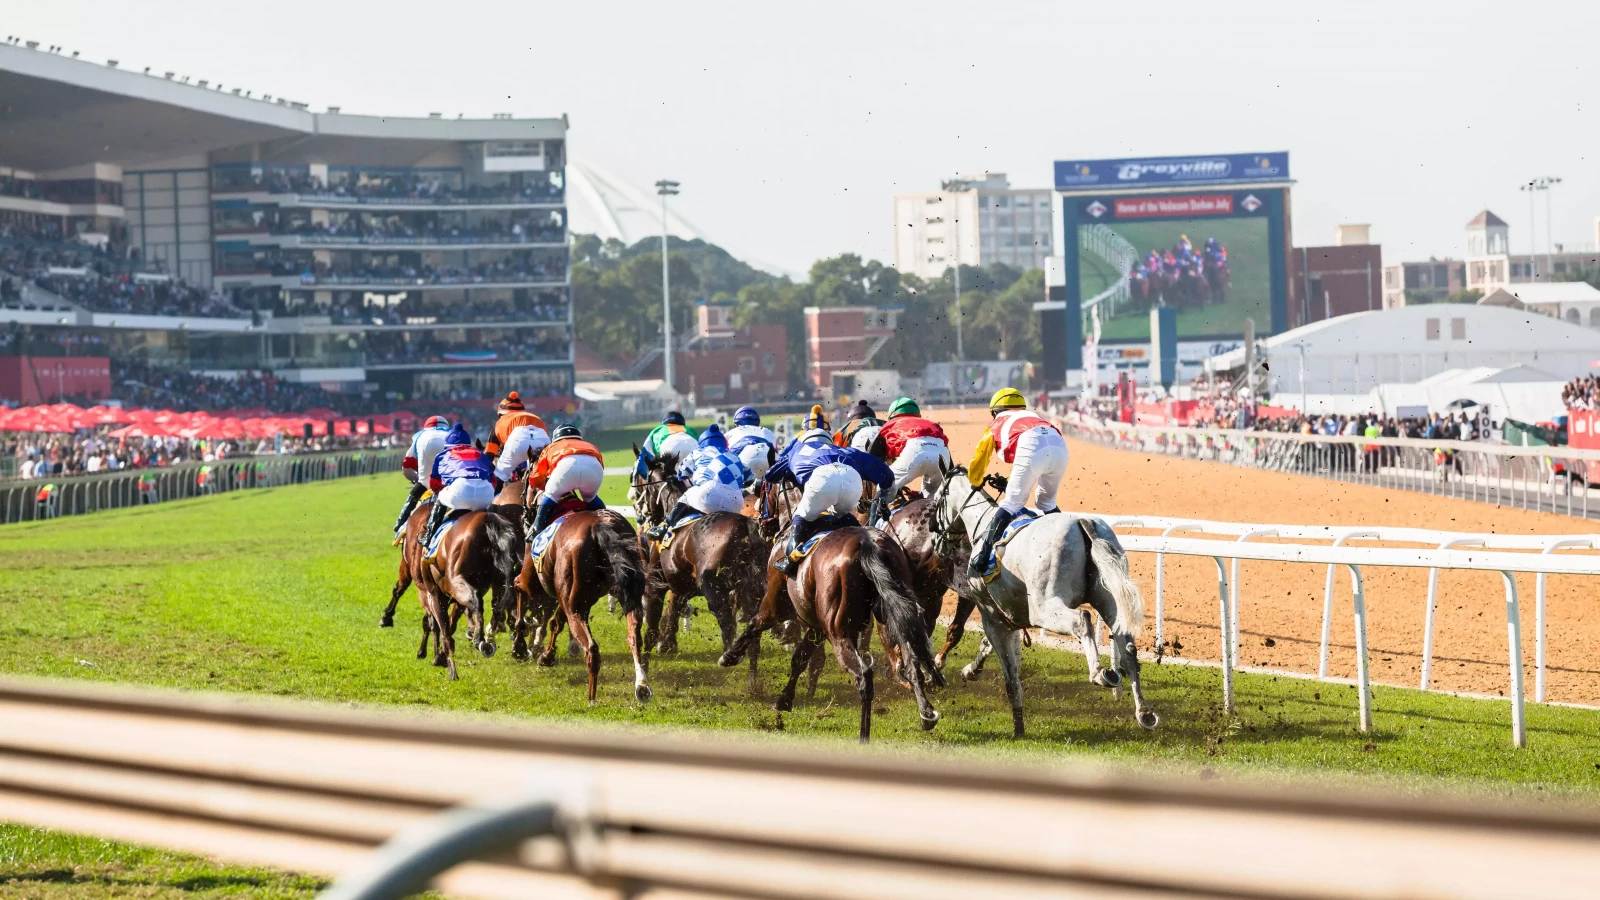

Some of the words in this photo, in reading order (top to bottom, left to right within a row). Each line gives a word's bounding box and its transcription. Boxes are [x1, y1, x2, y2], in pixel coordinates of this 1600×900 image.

[1117, 161, 1227, 180] Greyville
[1118, 202, 1137, 213] Home
[1139, 201, 1146, 212] of
[1147, 200, 1158, 212] the
[1215, 198, 1230, 212] July
[1481, 405, 1490, 438] 400
